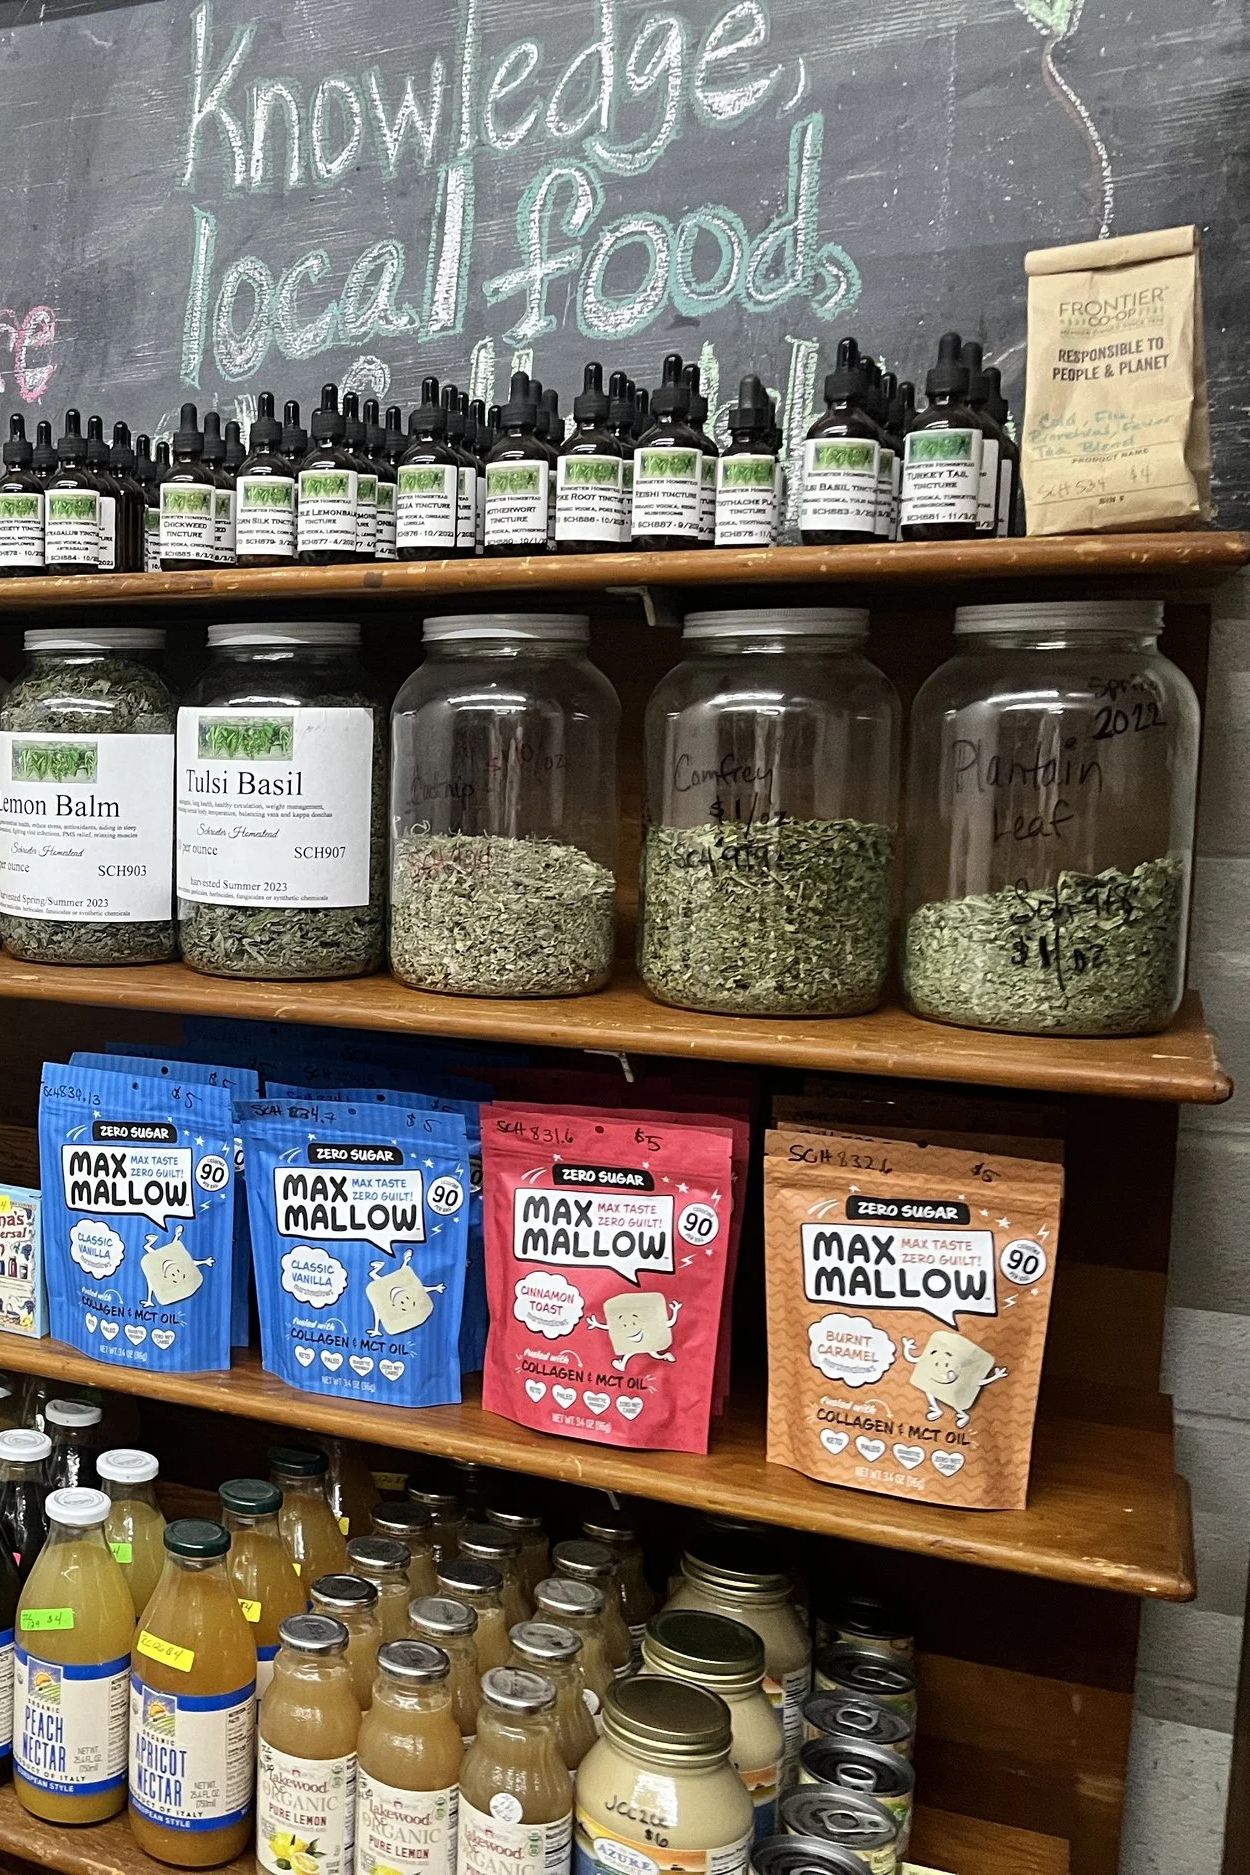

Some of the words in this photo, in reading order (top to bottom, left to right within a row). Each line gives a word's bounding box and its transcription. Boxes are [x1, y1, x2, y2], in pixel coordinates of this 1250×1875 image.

[181, 156, 476, 388] local
[1059, 287, 1165, 318] FRONTIER
[1087, 307, 1137, 328] CO-OP
[1057, 339, 1143, 364] RESPONSIBLE
[1147, 335, 1165, 350] TO
[1052, 366, 1099, 382] PEOPLE
[1104, 363, 1115, 378] &
[1119, 354, 1171, 376] PLANET
[906, 470, 944, 481] TURKEY
[946, 469, 969, 480] TAIL
[570, 492, 597, 502] ROOT
[1093, 701, 1166, 741] 2022
[952, 736, 1104, 793] Plantain
[185, 768, 228, 795] Tulsi
[237, 771, 305, 796] Basil
[674, 752, 774, 805] Comfrey
[55, 793, 121, 818] Balm
[228, 825, 280, 839] Homestead
[992, 799, 1075, 843] Leaf
[192, 845, 218, 856] ounce
[293, 846, 347, 859] SCH907
[7, 861, 30, 874] ounce
[97, 864, 148, 877] SCH903
[222, 879, 261, 892] Summer
[263, 881, 288, 892] 2023
[86, 898, 110, 908] 2023
[100, 1125, 129, 1138] ZERO
[130, 1126, 170, 1140] SUGAR
[69, 1151, 128, 1180] MAX
[130, 1155, 150, 1166] MAX
[152, 1156, 179, 1167] TASTE
[316, 1148, 348, 1162] ZERO
[350, 1148, 396, 1163] SUGAR
[130, 1167, 154, 1178] ZERO
[155, 1168, 184, 1180] GUILT!
[199, 1163, 226, 1185] 90
[351, 1178, 374, 1189] MAX
[375, 1178, 407, 1189] TASTE
[561, 1168, 596, 1183] ZERO
[598, 1170, 645, 1187] SUGAR
[70, 1179, 188, 1208] MALLOW
[283, 1173, 349, 1204] MAX
[352, 1191, 380, 1202] ZERO
[380, 1191, 414, 1203] GUILT!
[431, 1185, 459, 1208] 90
[284, 1202, 418, 1233] MALLOW
[523, 1196, 593, 1229] MAX
[598, 1202, 621, 1214] MAX
[623, 1203, 657, 1215] TASTE
[857, 1201, 899, 1217] ZERO
[901, 1203, 959, 1220] SUGAR
[598, 1216, 625, 1227] ZERO
[628, 1217, 663, 1229] GUILT!
[683, 1212, 713, 1238] 90
[77, 1232, 114, 1248] CLASSIC
[522, 1227, 667, 1260] MALLOW
[813, 1231, 896, 1266] MAX
[901, 1237, 929, 1250] MAX
[932, 1238, 973, 1252] TASTE
[78, 1244, 112, 1261] VANILLA
[901, 1252, 935, 1265] ZERO
[938, 1253, 982, 1267] GUILT!
[1006, 1248, 1040, 1276] 90
[290, 1259, 335, 1275] CLASSIC
[291, 1272, 333, 1288] VANILLA
[814, 1265, 987, 1301] MALLOW
[520, 1285, 575, 1305] CINNAMON
[81, 1295, 126, 1318] COLLAGEN
[134, 1309, 158, 1323] MCT
[160, 1313, 180, 1326] OIL
[529, 1300, 564, 1316] TOAST
[290, 1327, 350, 1348] COLLAGEN
[360, 1339, 387, 1354] MCT
[388, 1343, 410, 1356] OIL
[825, 1330, 873, 1347] BURNT
[817, 1343, 879, 1363] CARAMEL
[521, 1359, 584, 1383] COLLAGEN
[596, 1374, 624, 1389] MCT
[626, 1377, 648, 1391] OIL
[816, 1408, 894, 1435] COLLAGEN
[908, 1425, 942, 1442] MCT
[945, 1430, 971, 1446] OIL
[24, 1704, 64, 1744] PEACH
[21, 1732, 67, 1773] NECTAR
[135, 1732, 188, 1779] APRICOT
[44, 1771, 56, 1780] OF
[59, 1774, 86, 1783] ITALY
[49, 1781, 75, 1793] STYLE
[136, 1763, 182, 1808] NECTAR
[268, 1768, 330, 1794] Lakewood
[261, 1780, 340, 1813] ORGANIC
[159, 1805, 172, 1814] OF
[176, 1809, 203, 1818] ITALY
[165, 1816, 192, 1829] STYLE
[268, 1802, 292, 1822] PURE
[294, 1812, 328, 1827] LEMON
[368, 1798, 432, 1827] Lakewood
[361, 1811, 443, 1845] ORGANIC
[368, 1834, 392, 1854] PURE
[395, 1845, 430, 1860] LEMON
[598, 1843, 653, 1871] AZURE
